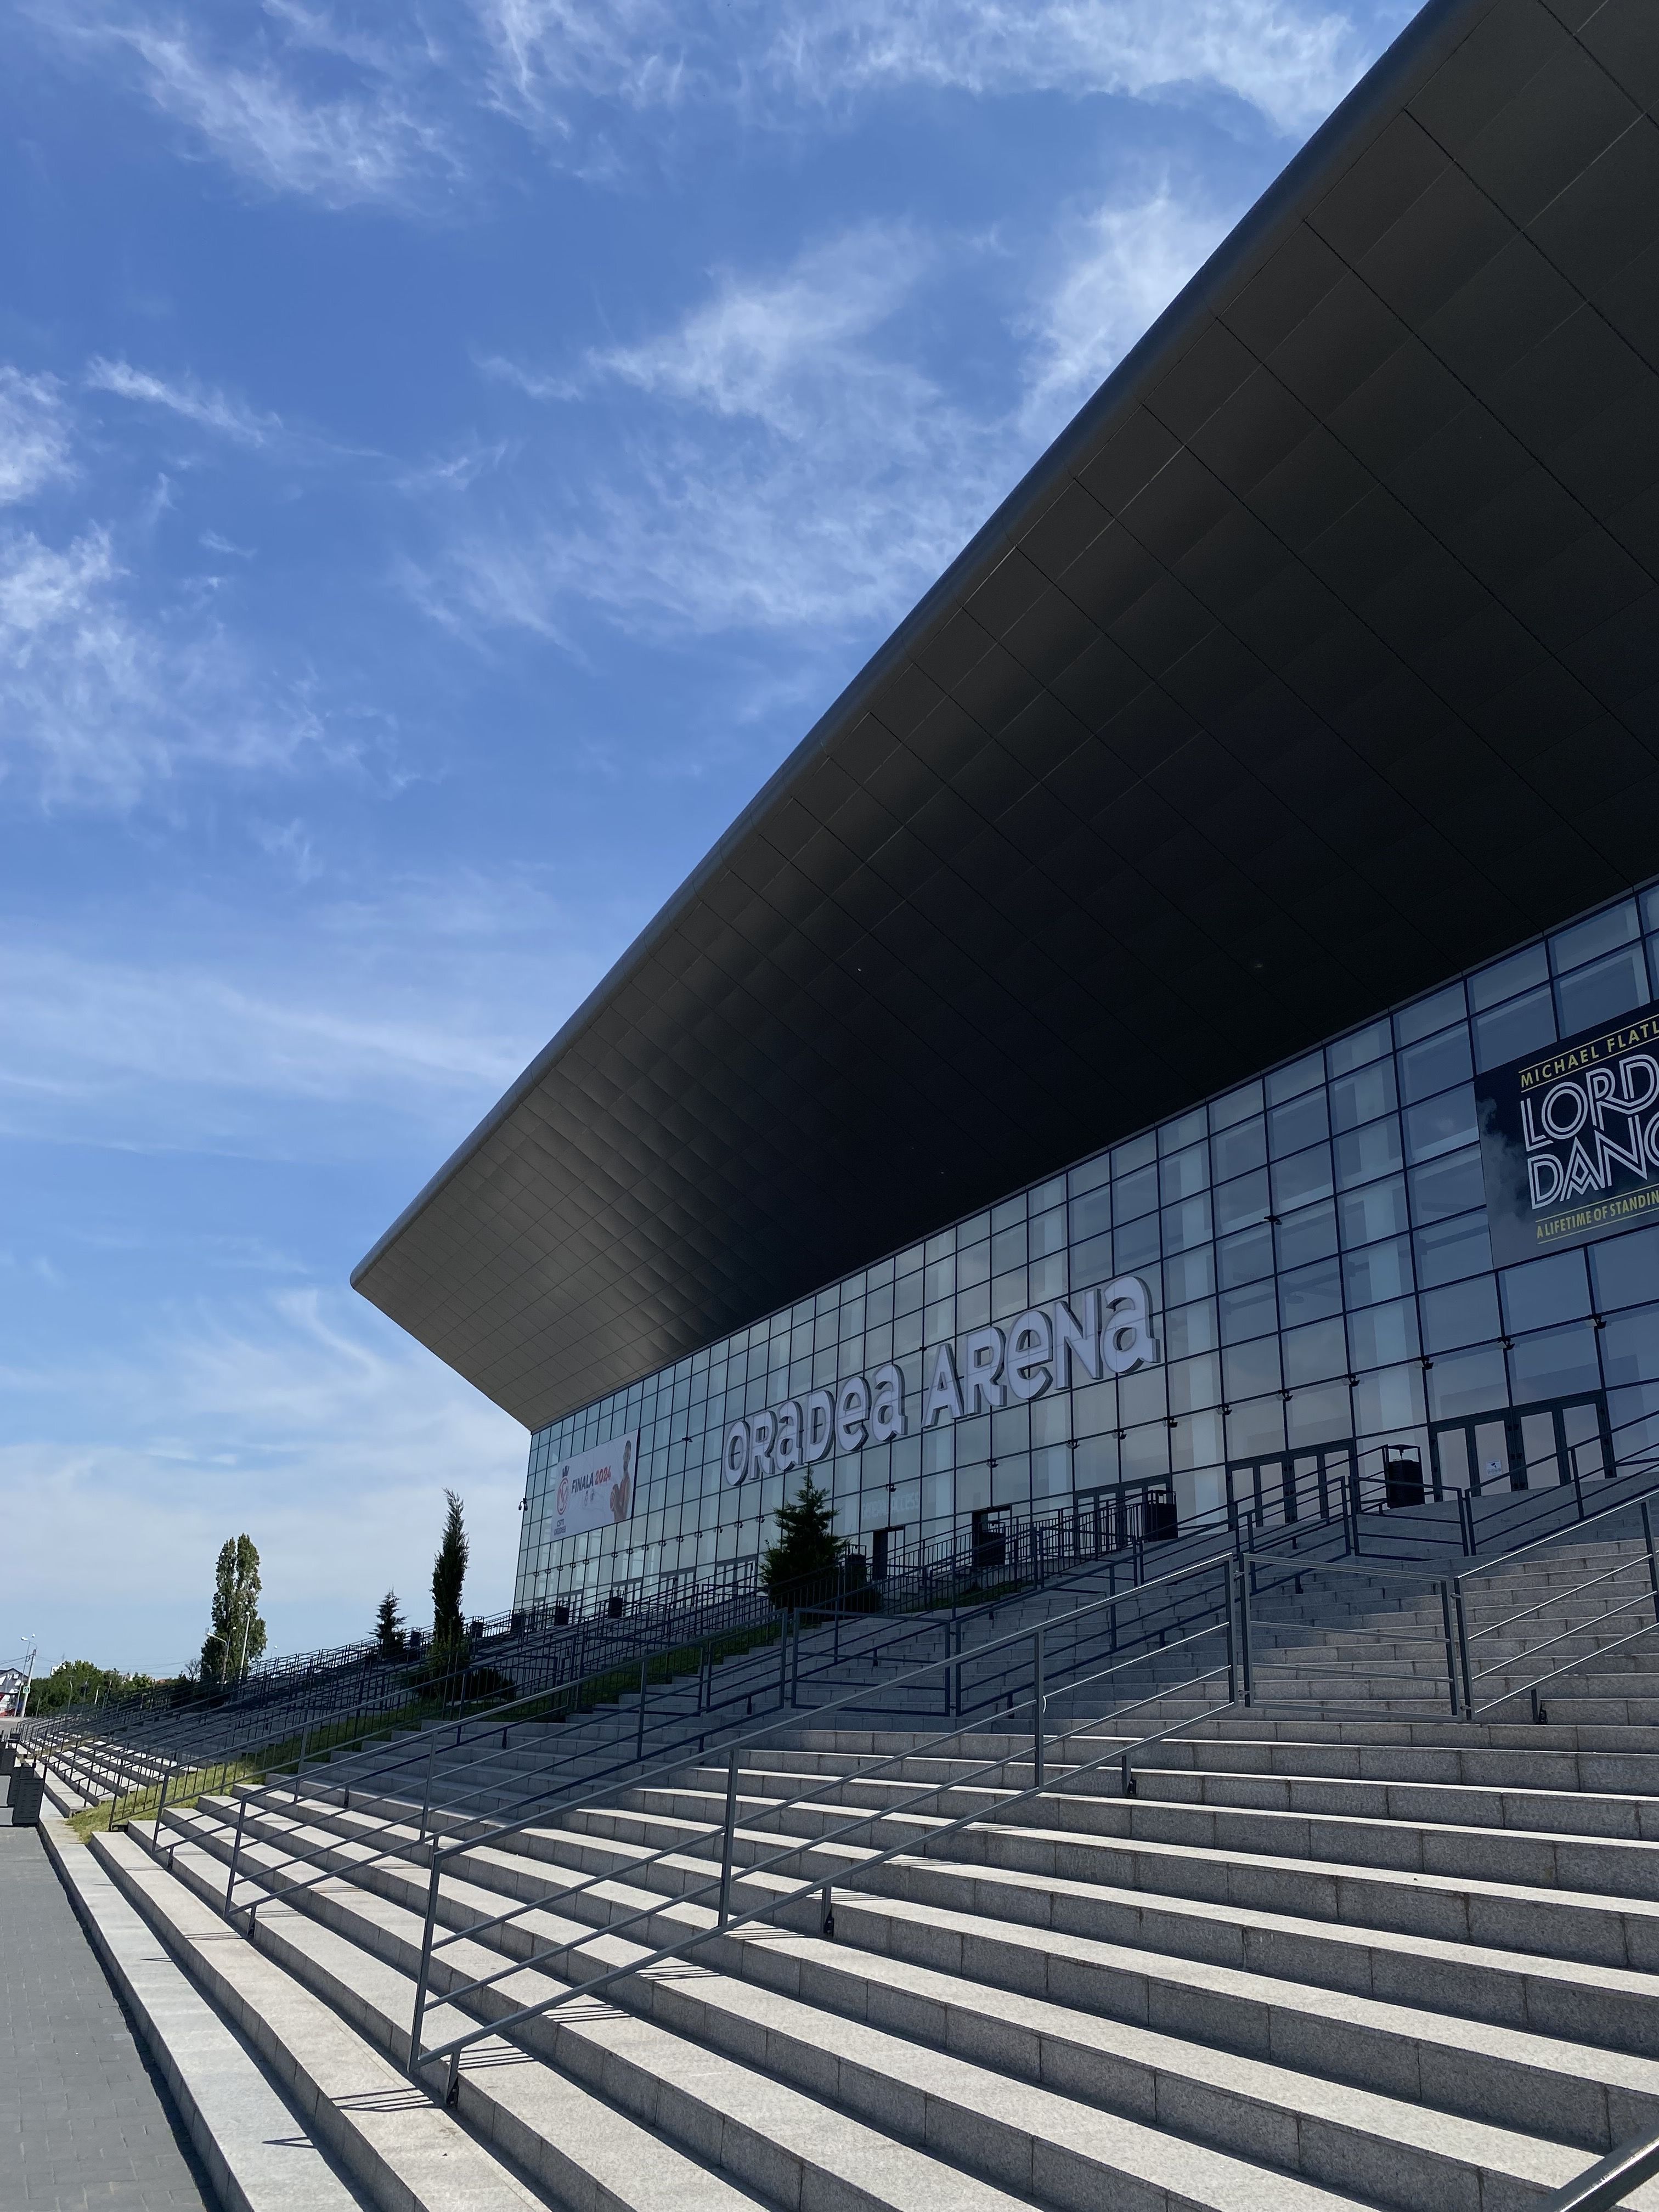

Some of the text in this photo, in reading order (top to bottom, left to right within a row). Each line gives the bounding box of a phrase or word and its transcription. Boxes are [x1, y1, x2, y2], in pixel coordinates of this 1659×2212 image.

[1521, 1046, 1599, 1088] MICHAEL
[1520, 1054, 1659, 1152] LORD
[1537, 1226, 1544, 1239] A
[1544, 1211, 1592, 1236] LIFETIME
[1594, 1206, 1607, 1221] OF
[571, 1472, 594, 1494] FINALA
